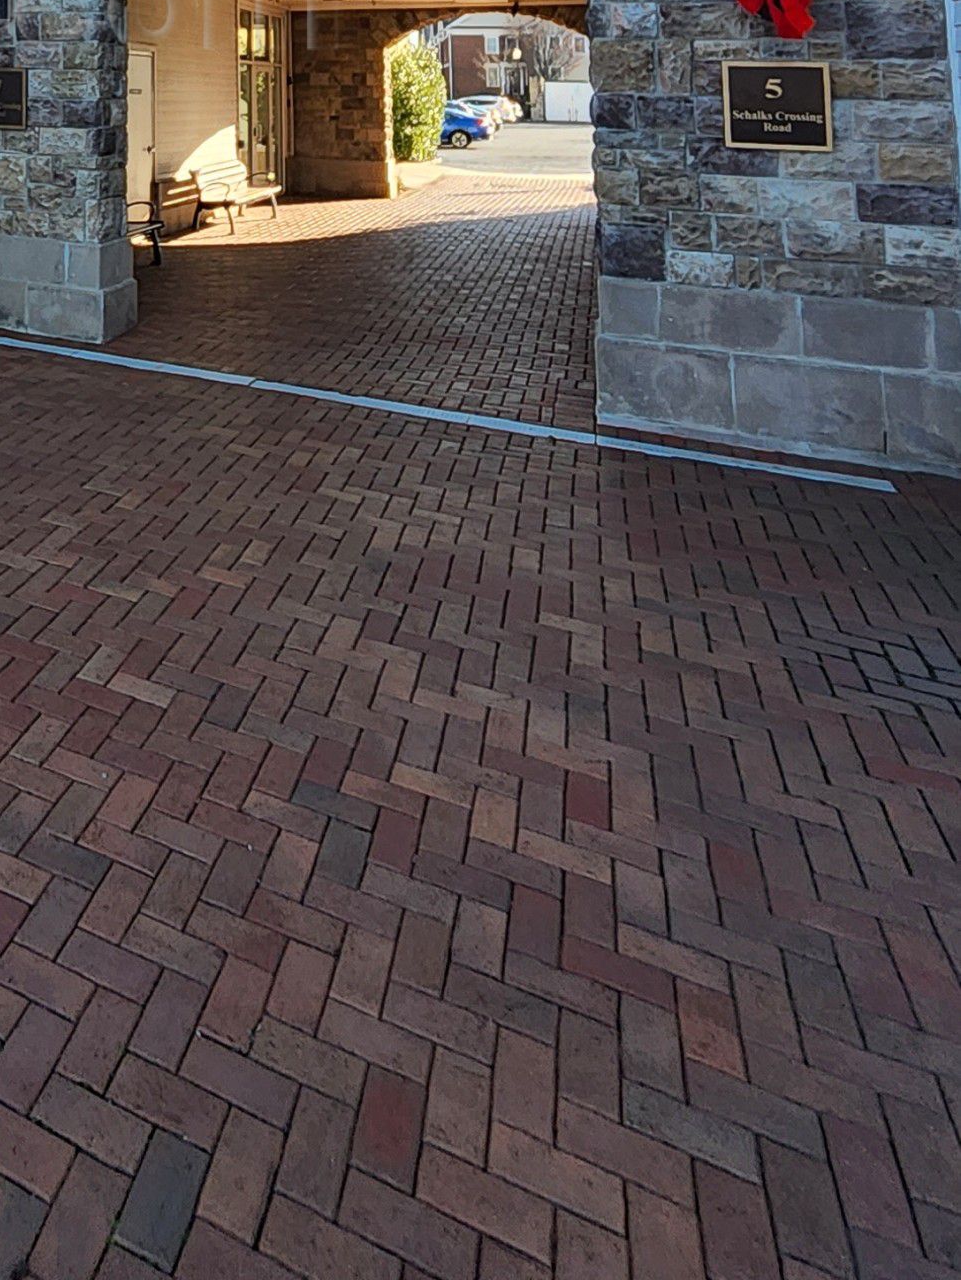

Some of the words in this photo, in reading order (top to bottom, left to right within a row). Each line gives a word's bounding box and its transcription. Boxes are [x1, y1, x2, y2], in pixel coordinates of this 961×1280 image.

[764, 78, 783, 99] 5
[732, 109, 773, 121] Schalks
[775, 111, 823, 124] Crossing
[763, 122, 792, 133] Road
